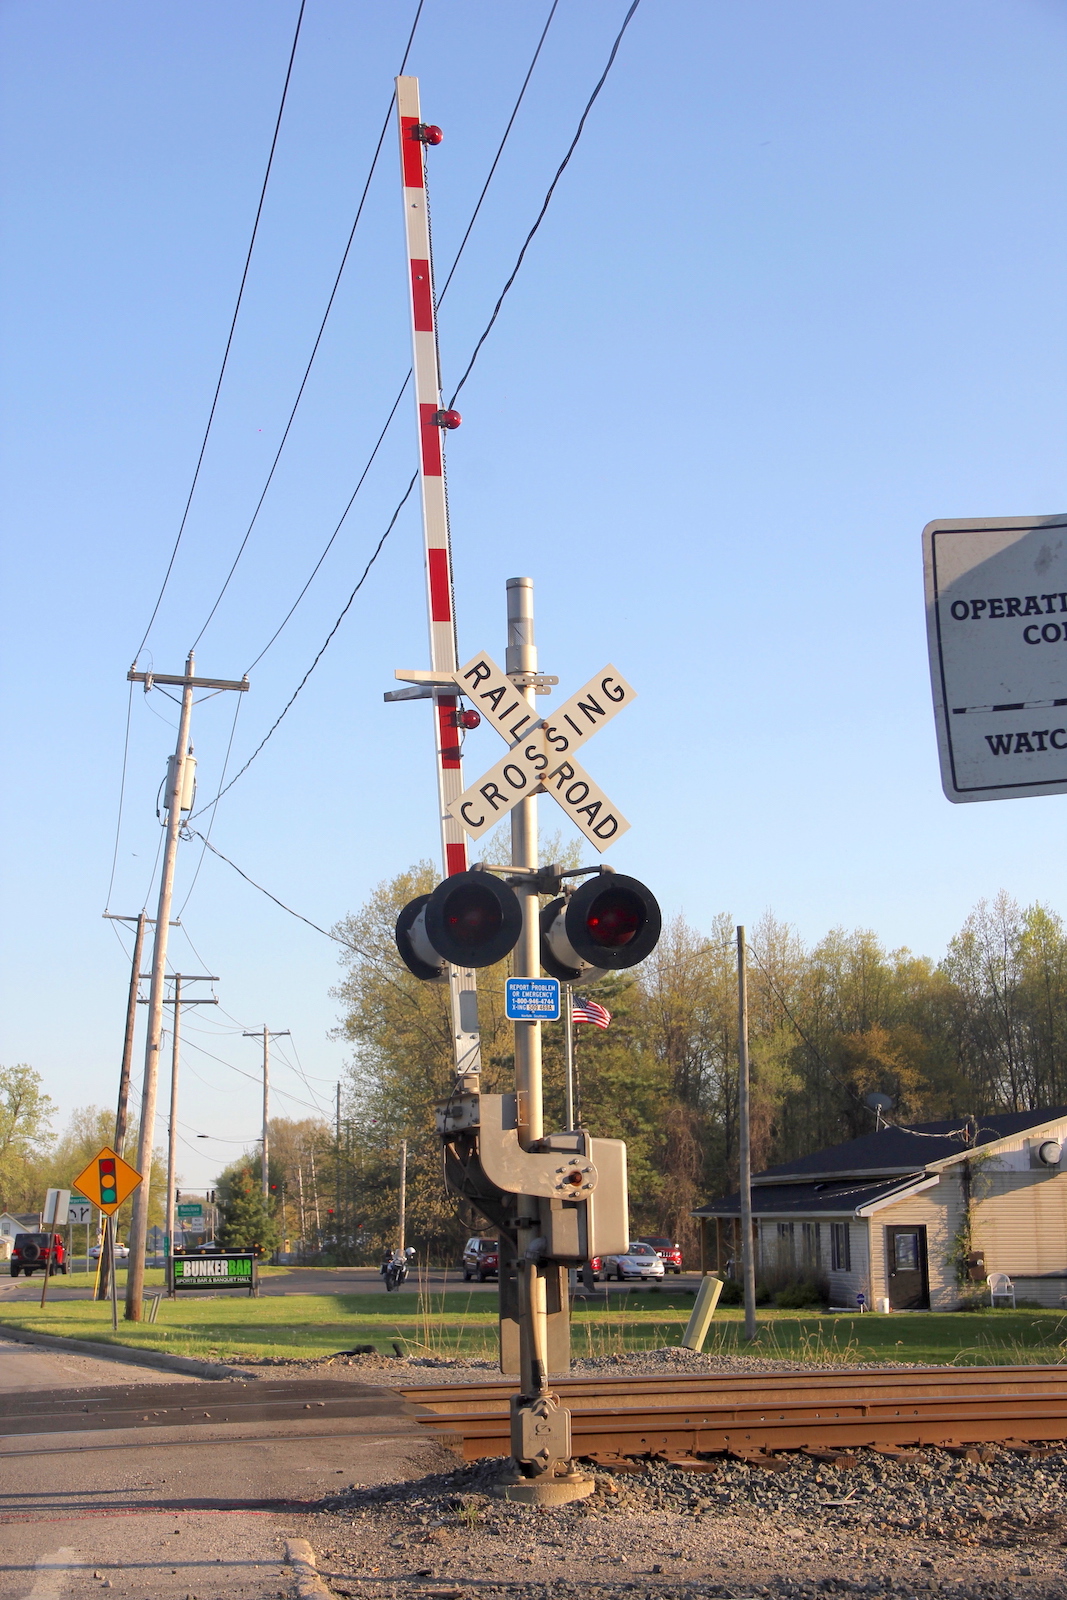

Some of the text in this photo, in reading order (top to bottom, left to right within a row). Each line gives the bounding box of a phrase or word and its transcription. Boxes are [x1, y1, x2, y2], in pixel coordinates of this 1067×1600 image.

[950, 593, 1067, 621] OPERATI
[460, 677, 625, 827] CROSSING
[463, 660, 618, 840] RAIL ROAD
[984, 728, 1067, 756] WATC
[174, 1261, 183, 1277] THE
